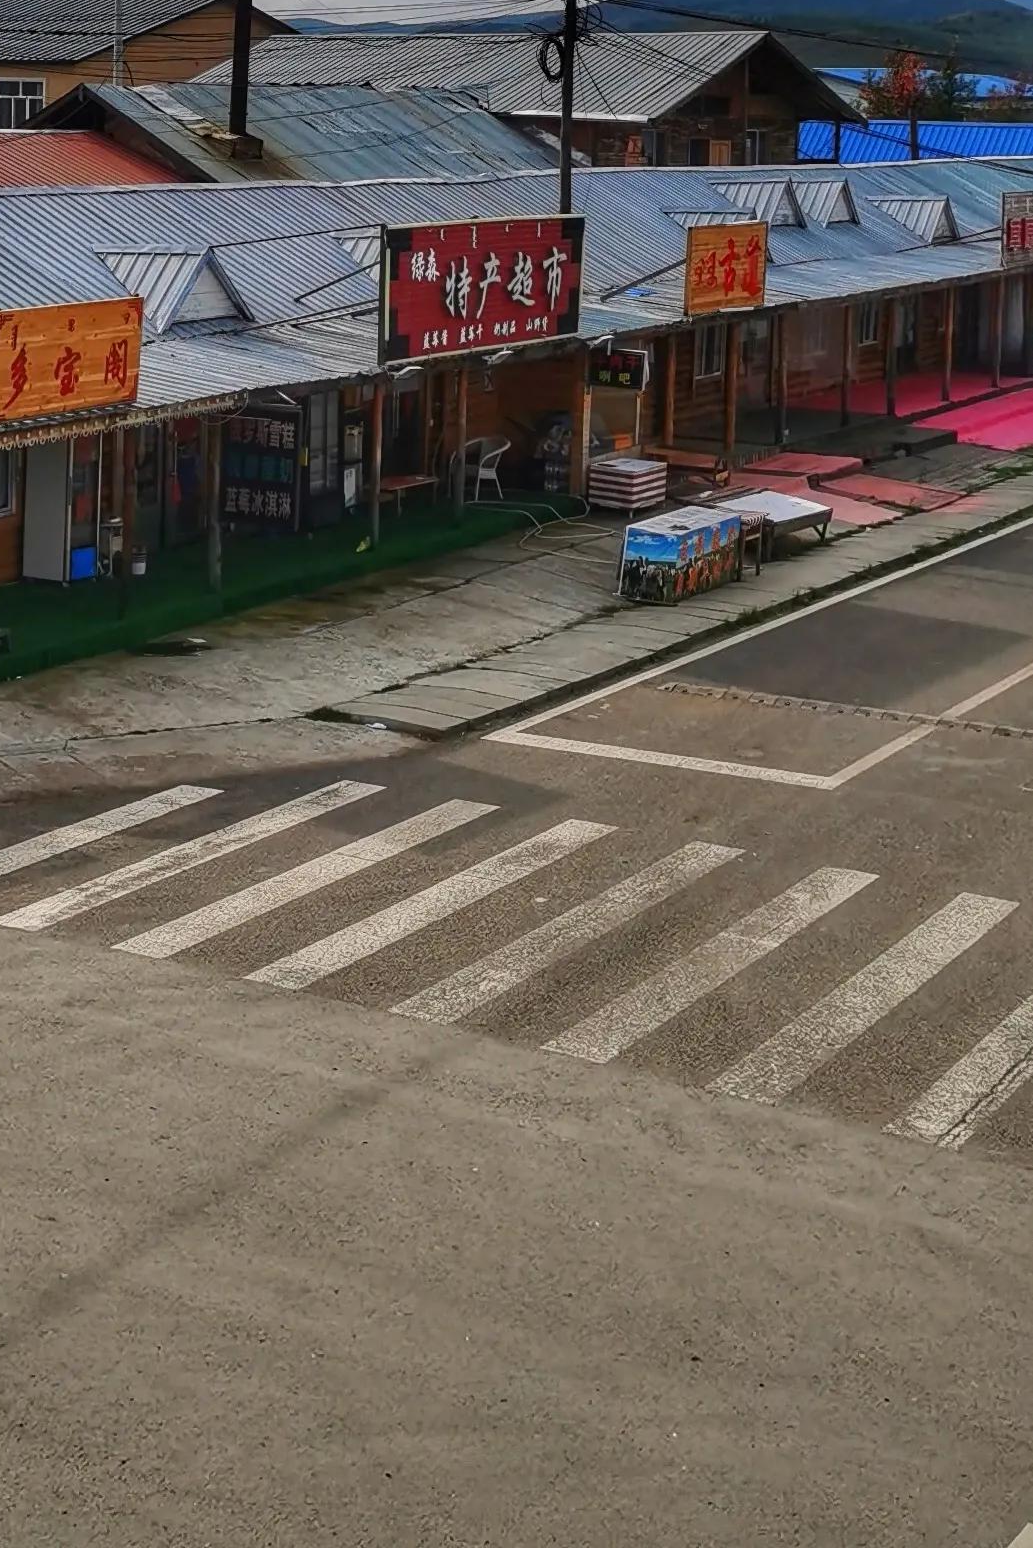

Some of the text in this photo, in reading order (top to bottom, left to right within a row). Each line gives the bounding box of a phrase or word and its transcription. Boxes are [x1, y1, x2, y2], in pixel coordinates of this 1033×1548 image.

[445, 245, 568, 321] 特产超市
[2, 338, 129, 411] 多宝阁
[224, 485, 292, 521] 蓝莓冰淇淋
